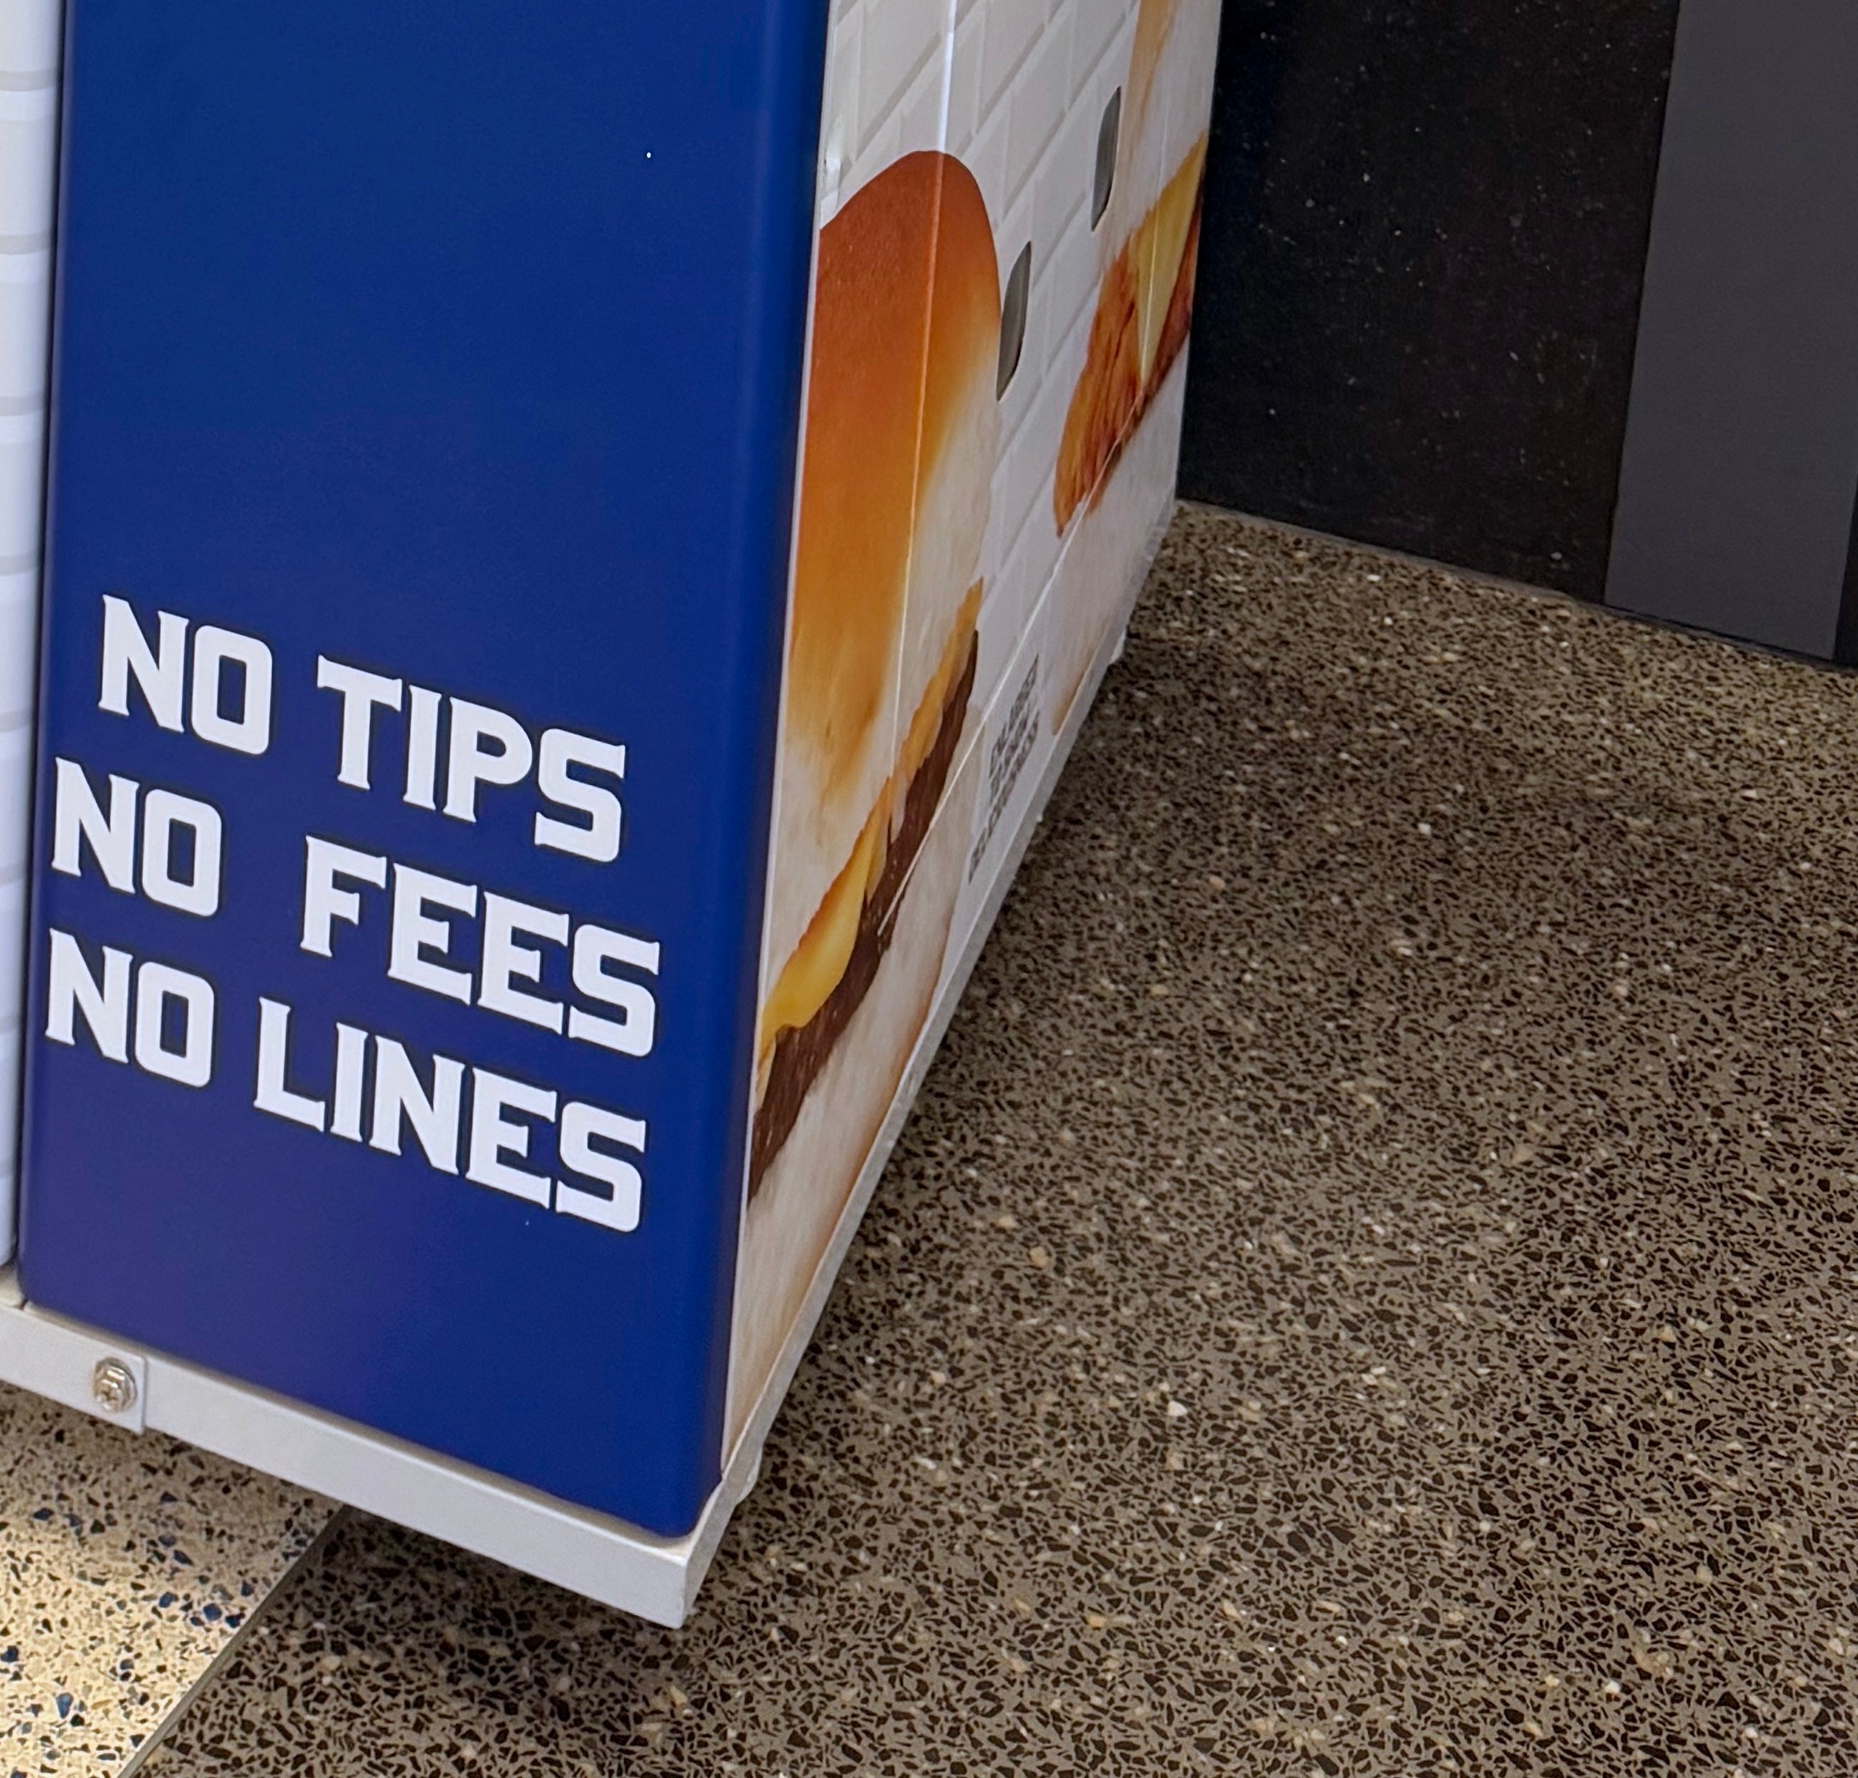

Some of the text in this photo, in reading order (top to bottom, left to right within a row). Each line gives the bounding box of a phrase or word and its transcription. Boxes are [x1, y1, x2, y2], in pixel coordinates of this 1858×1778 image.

[98, 594, 626, 863] NO TIPS
[52, 756, 660, 1057] NO FEES
[45, 928, 647, 1233] NO LINES
